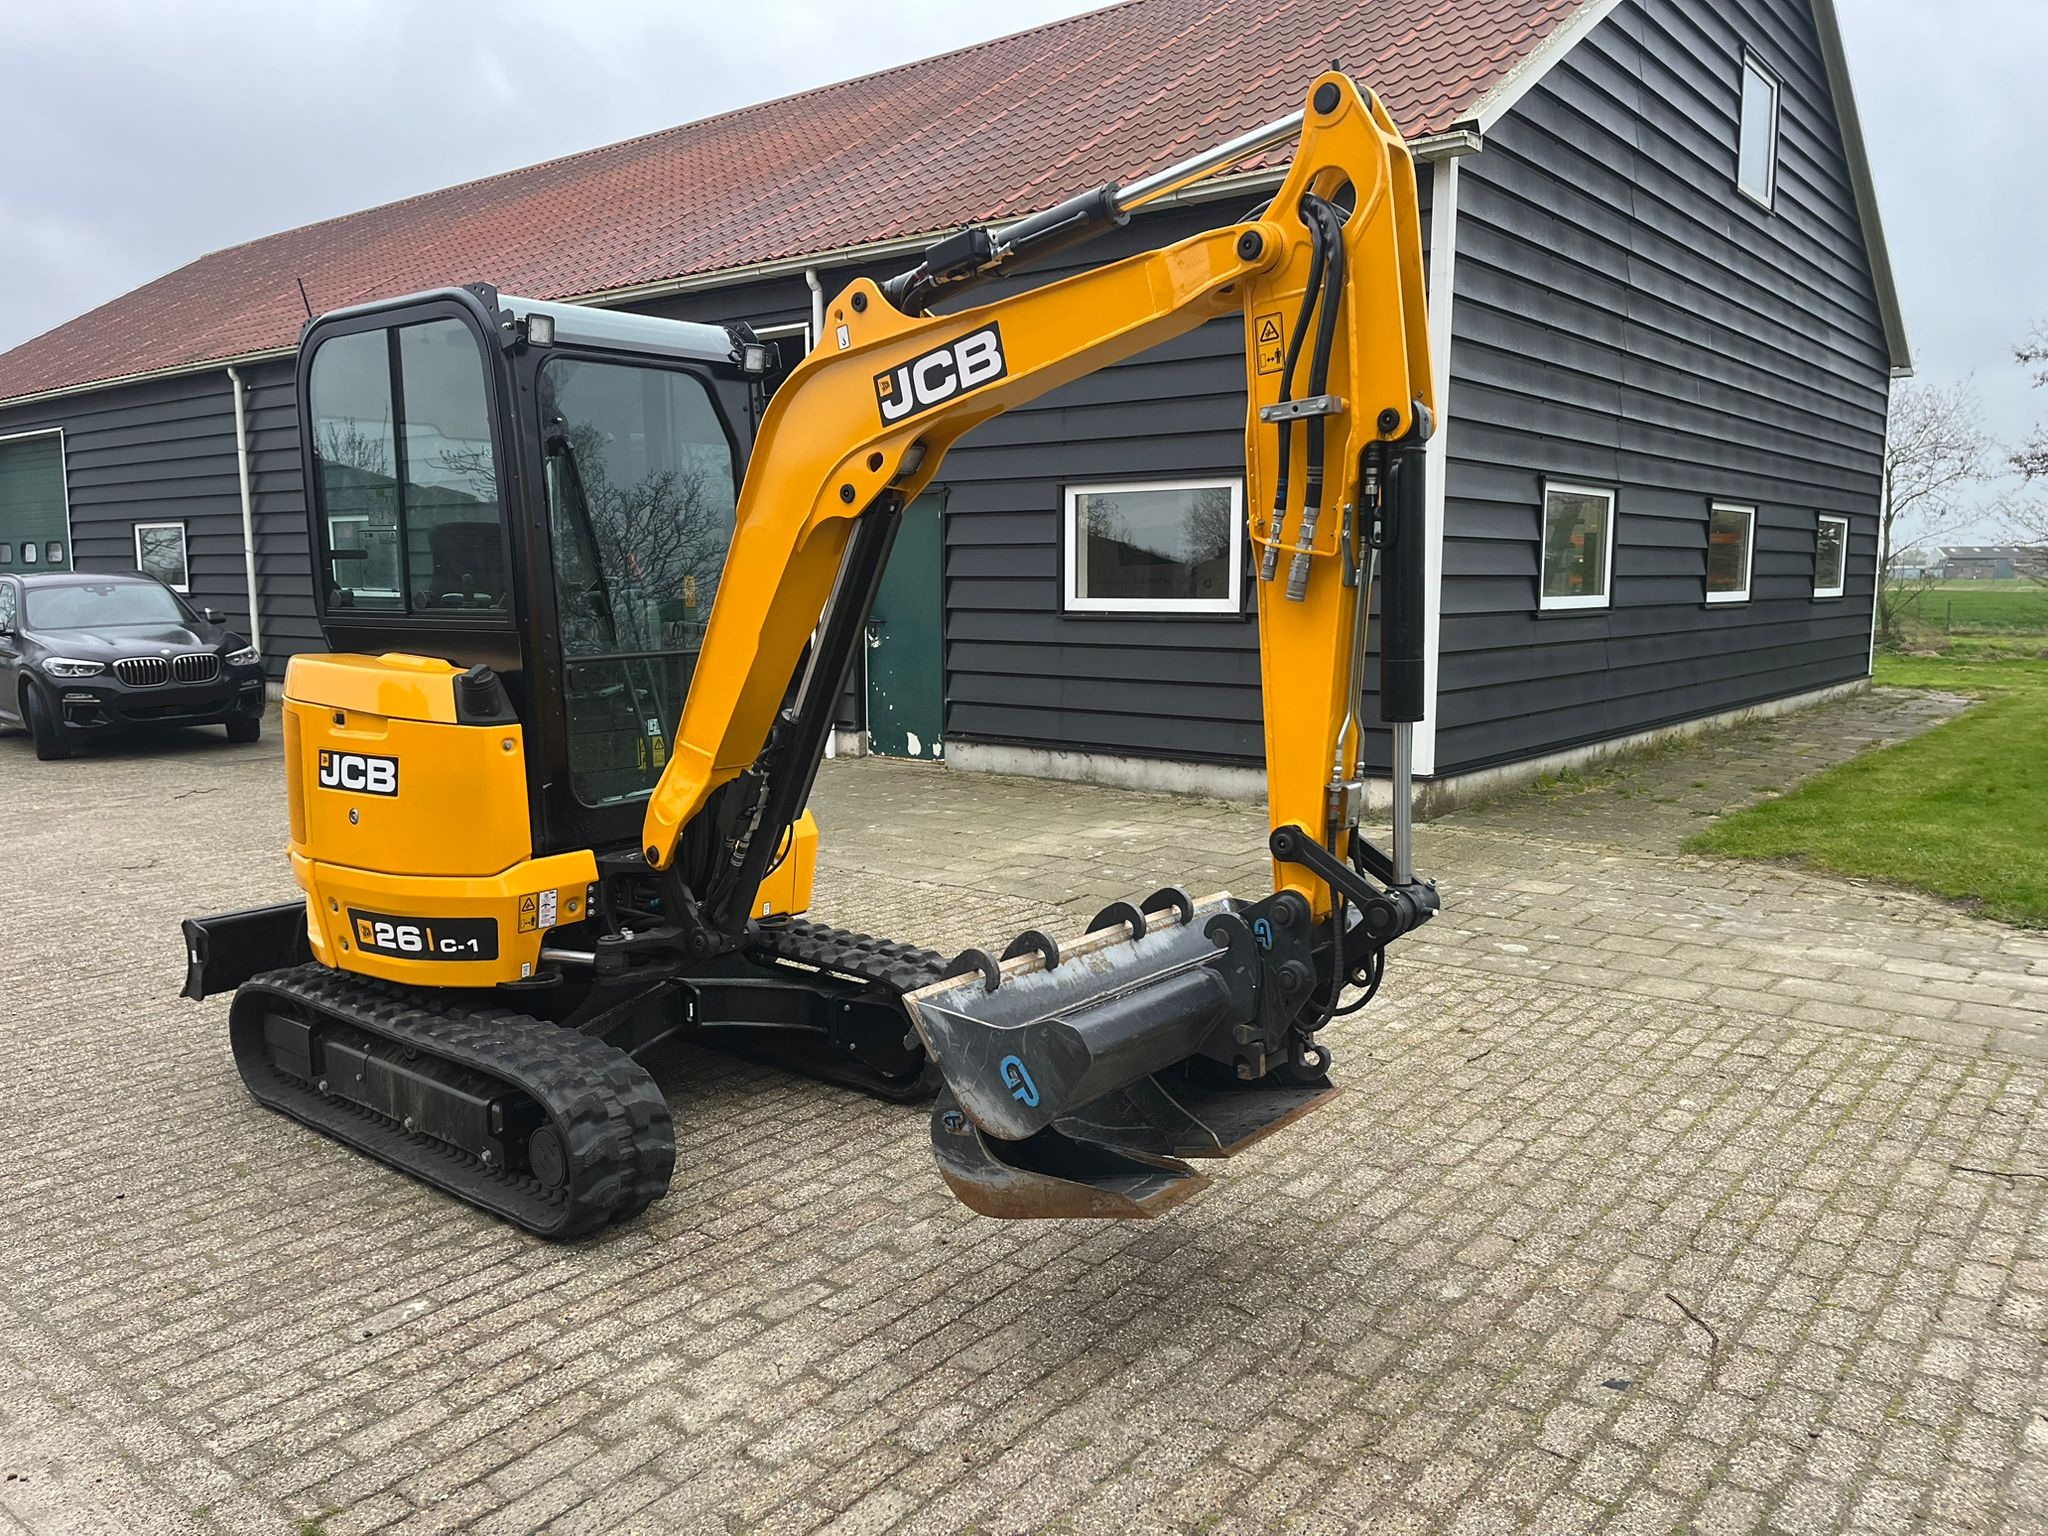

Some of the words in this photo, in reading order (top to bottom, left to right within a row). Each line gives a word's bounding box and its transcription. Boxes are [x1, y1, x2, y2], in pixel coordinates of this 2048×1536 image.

[881, 330, 1002, 419] JCB
[320, 754, 396, 793] JCB
[374, 922, 423, 952] 26
[440, 938, 479, 953] C-1
